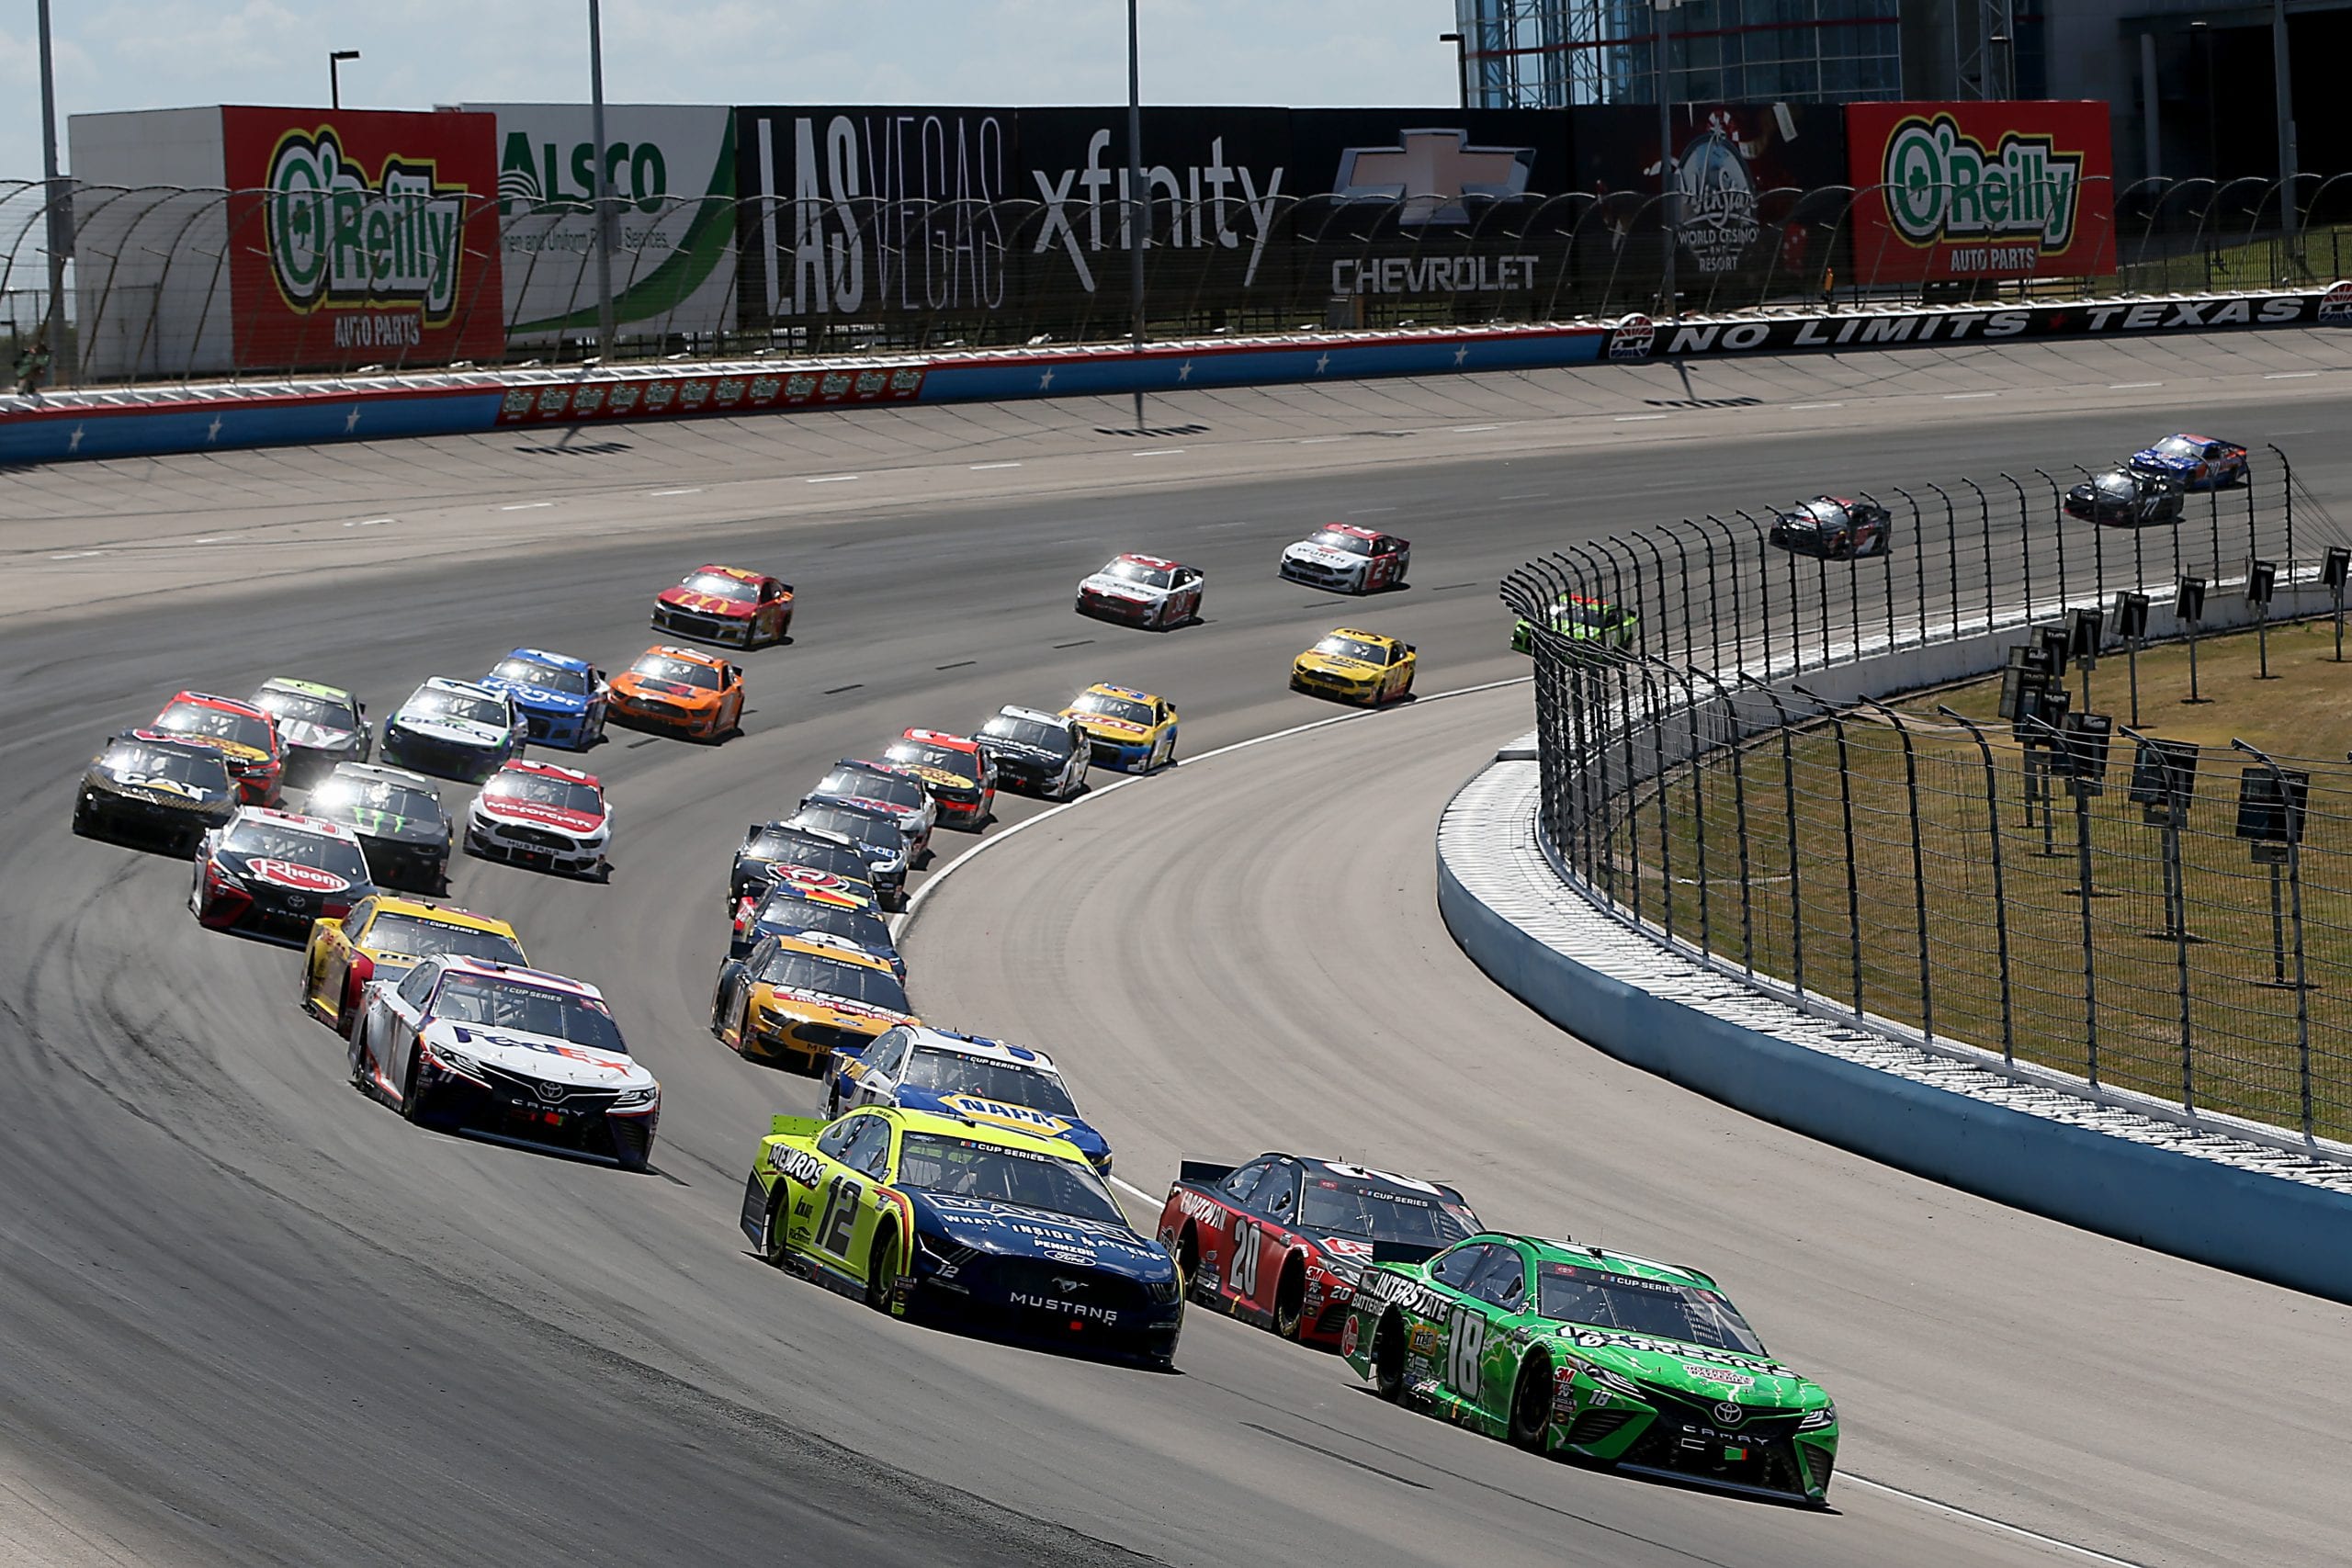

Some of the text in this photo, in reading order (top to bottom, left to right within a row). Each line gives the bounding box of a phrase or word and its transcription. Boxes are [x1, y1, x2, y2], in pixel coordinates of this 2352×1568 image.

[499, 131, 666, 215] ALSCO
[1891, 127, 2073, 239] O'Reilly
[274, 144, 458, 307] O'Reilly
[757, 116, 1003, 316] LAS VEGAS
[1032, 129, 1283, 292] xfinity
[1678, 230, 1716, 244] WORLD
[1951, 247, 2035, 272] AUTO PARTS
[1332, 256, 1539, 295] CHEVROLET
[2086, 298, 2303, 330] TEXAS
[334, 315, 420, 347] AUTO PARTS
[1668, 311, 2030, 353] NO LIMITS
[1072, 714, 1144, 732] GLAD
[508, 987, 562, 1003] CUP SERIES
[454, 1026, 632, 1078] FedEx
[969, 1055, 1022, 1072] CUP SERIES
[960, 1099, 1056, 1129] NAPA
[769, 1144, 826, 1186] MENARDS
[978, 1143, 1046, 1162] CUP SERIES
[1373, 1192, 1430, 1208] CUP SERIES
[814, 1174, 863, 1258] 12
[943, 1213, 1008, 1228] WHAT'S
[1012, 1224, 1076, 1242] INSIDE
[1034, 1238, 1098, 1258] PENNZOIL
[1230, 1217, 1261, 1297] 20
[935, 1263, 960, 1280] 12
[1616, 1276, 1679, 1294] CUP SERIES
[1010, 1292, 1118, 1322] MUSTANG
[1330, 1285, 1352, 1301] 20
[1374, 1272, 1450, 1322] INTERSTATE
[1449, 1308, 1486, 1397] 18
[1555, 1367, 1576, 1383] 3M
[1589, 1389, 1614, 1406] 18
